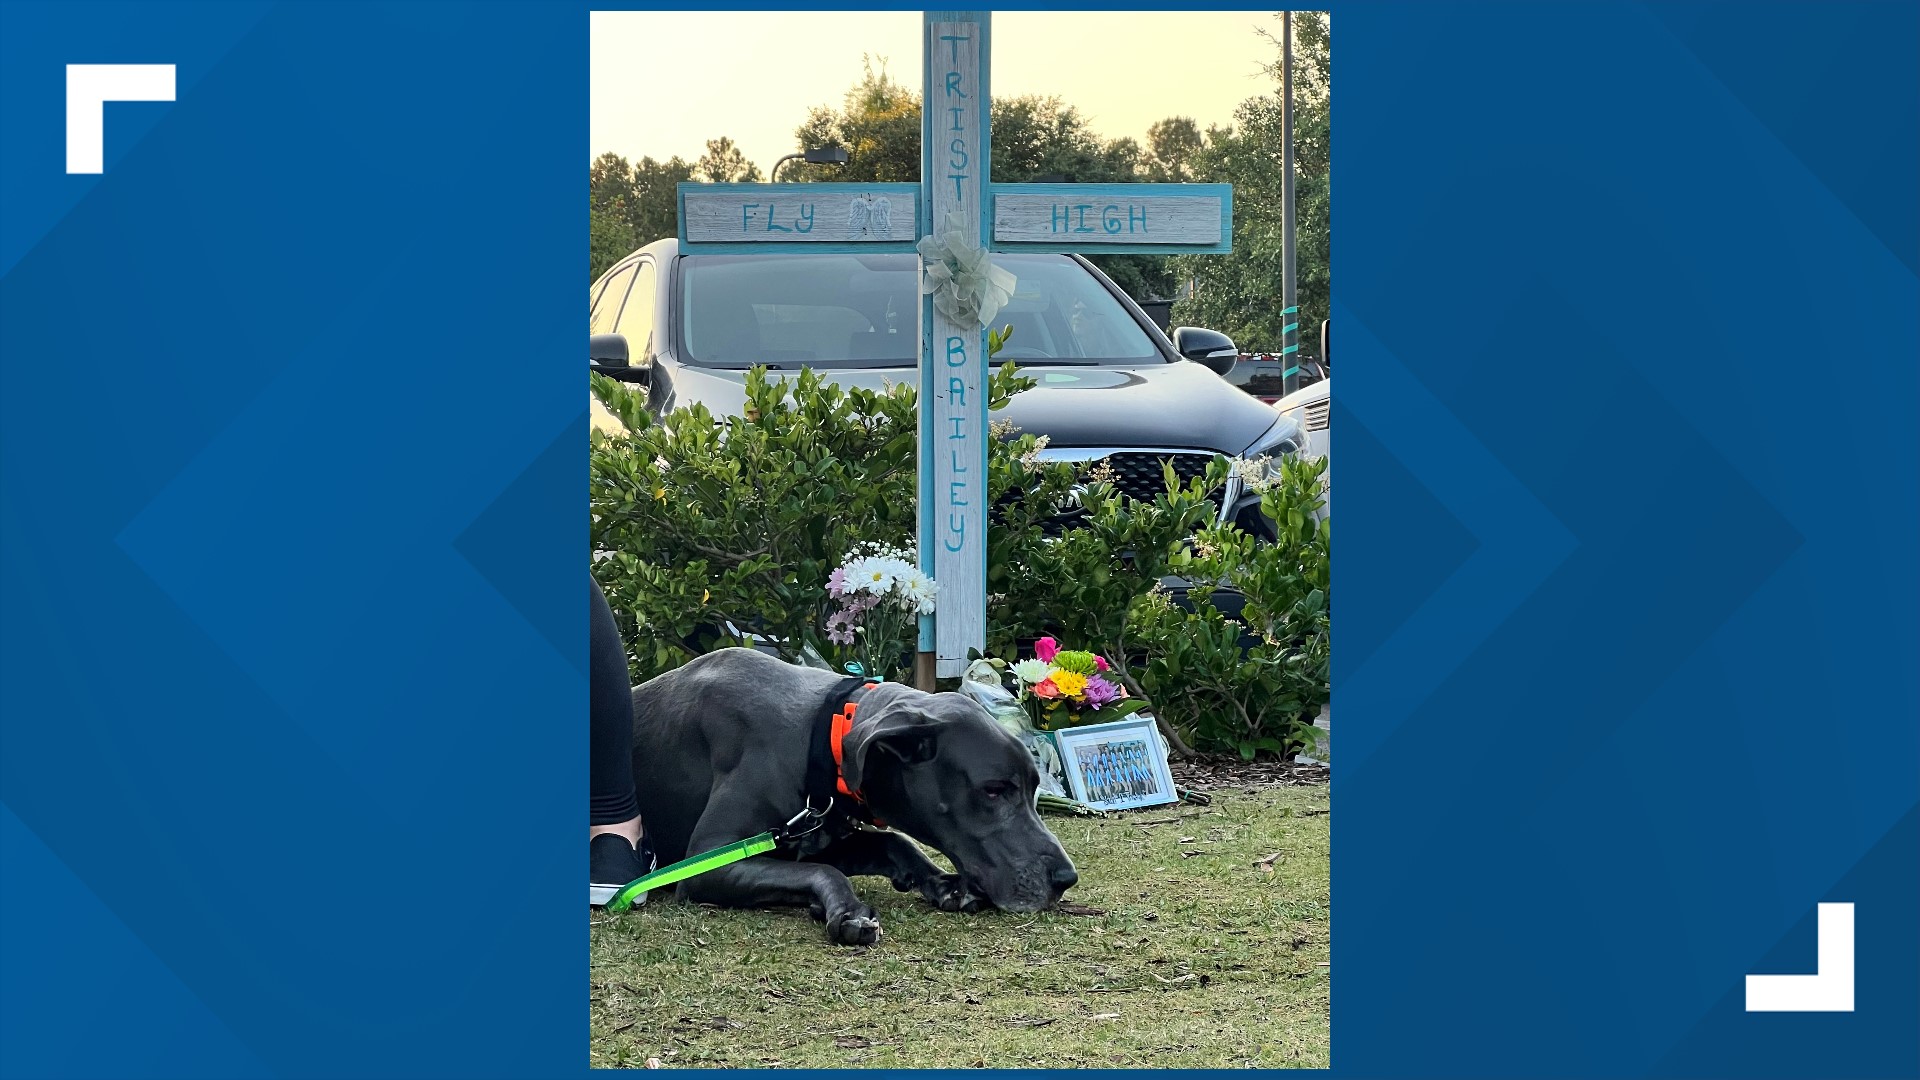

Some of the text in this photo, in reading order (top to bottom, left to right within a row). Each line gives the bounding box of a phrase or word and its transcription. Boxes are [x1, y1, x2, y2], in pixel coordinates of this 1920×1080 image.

[743, 203, 1148, 234] FLY HIGH
[940, 35, 970, 553] TRIST BAILEY
